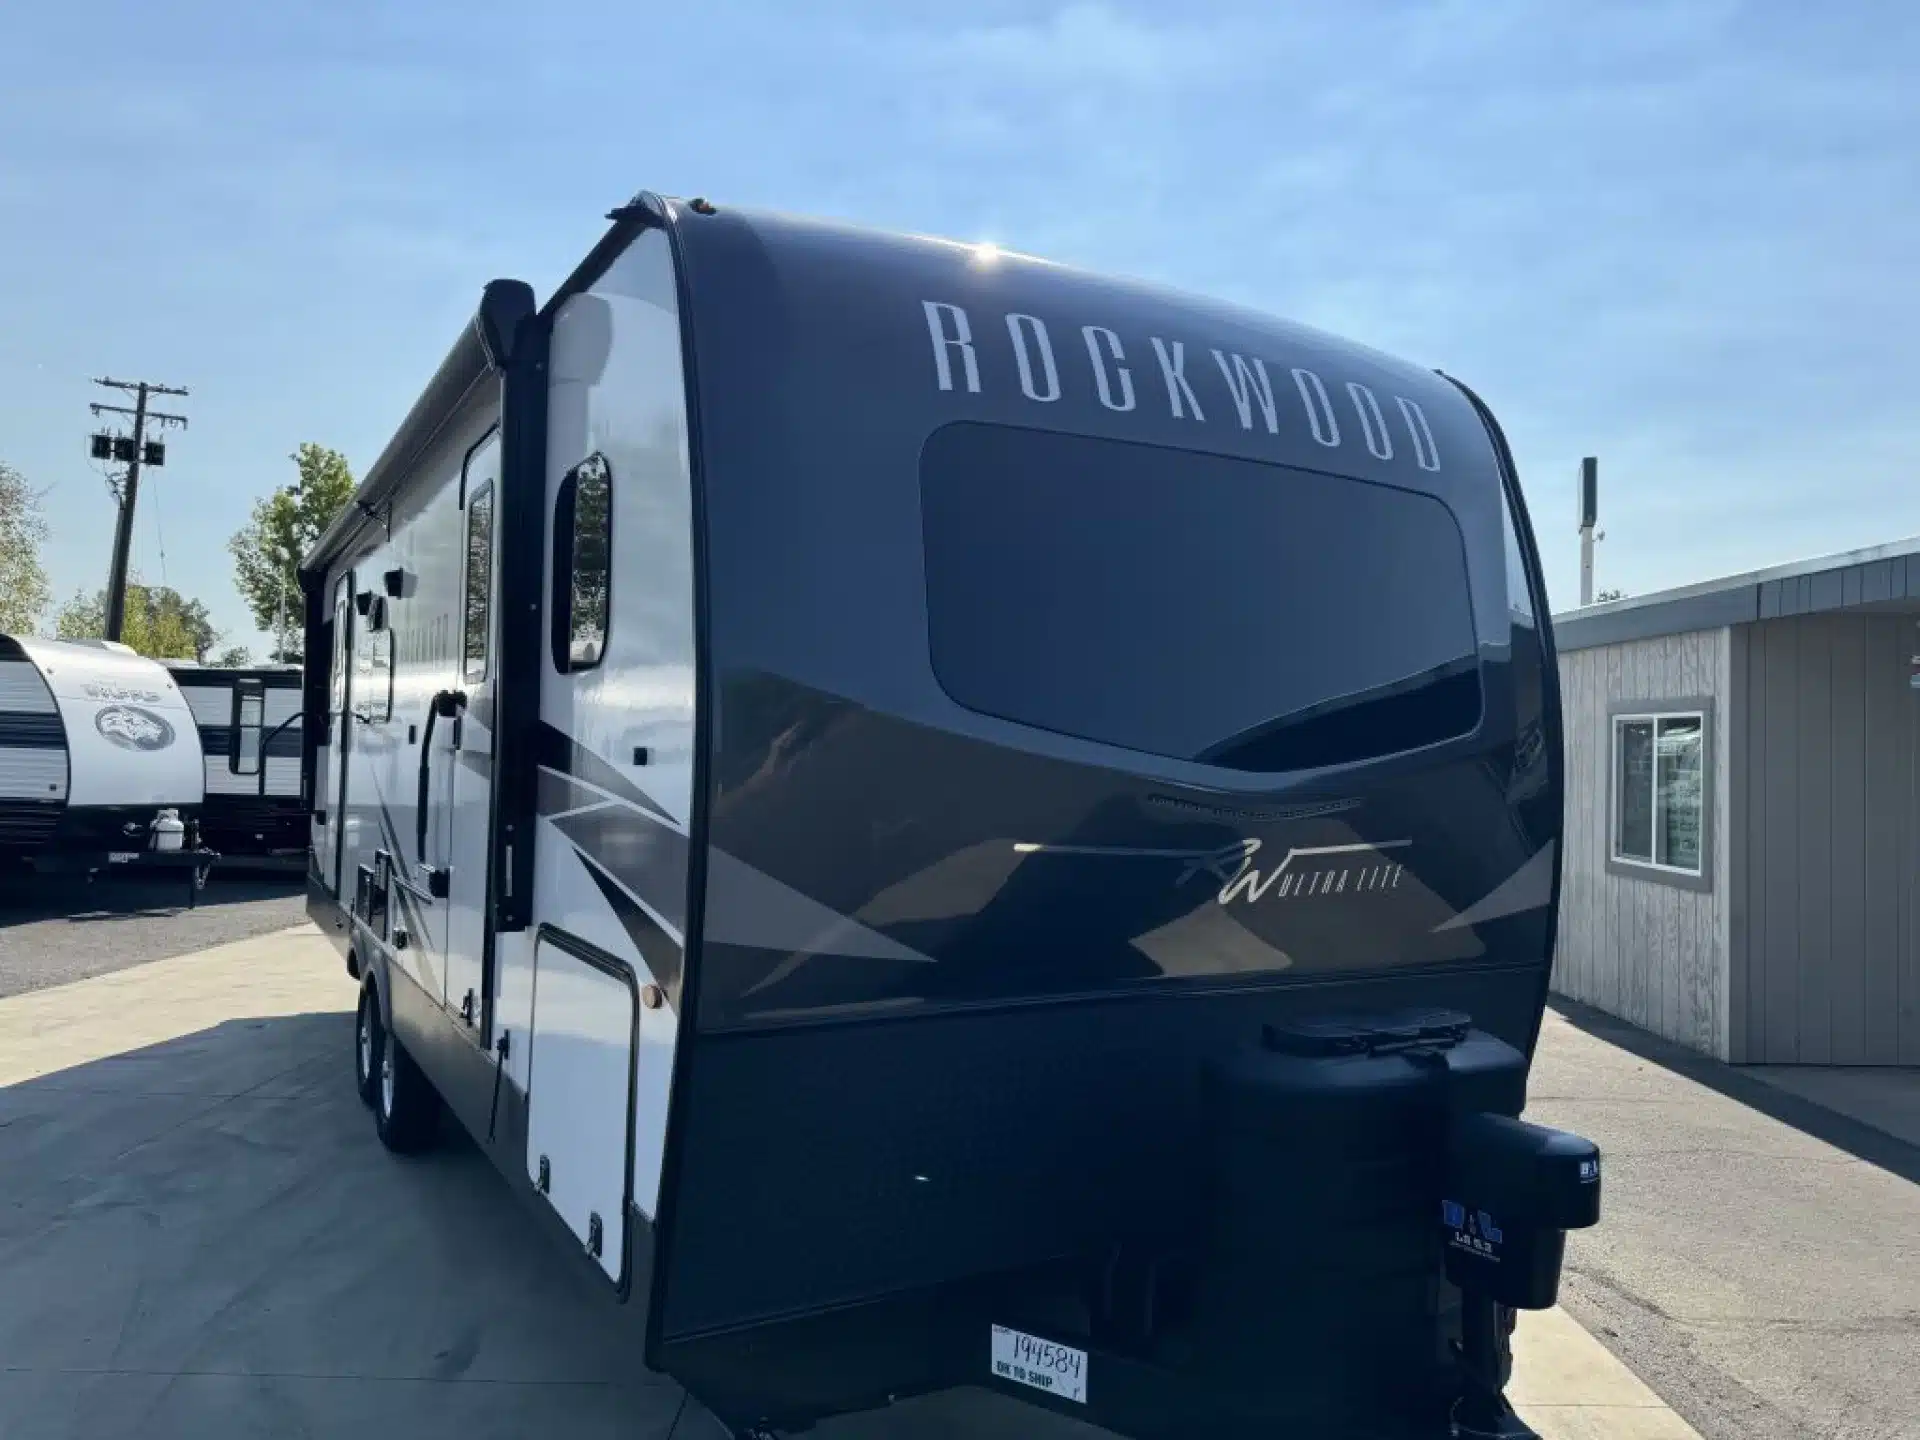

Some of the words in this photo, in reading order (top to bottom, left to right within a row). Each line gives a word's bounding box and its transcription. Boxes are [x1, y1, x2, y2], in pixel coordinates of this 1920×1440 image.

[920, 300, 1442, 473] ROCKWOOD
[1278, 868, 1349, 898] ULTRA
[1356, 863, 1405, 892] LITE
[1013, 1334, 1081, 1379] 194584
[1028, 1370, 1053, 1388] SHIP
